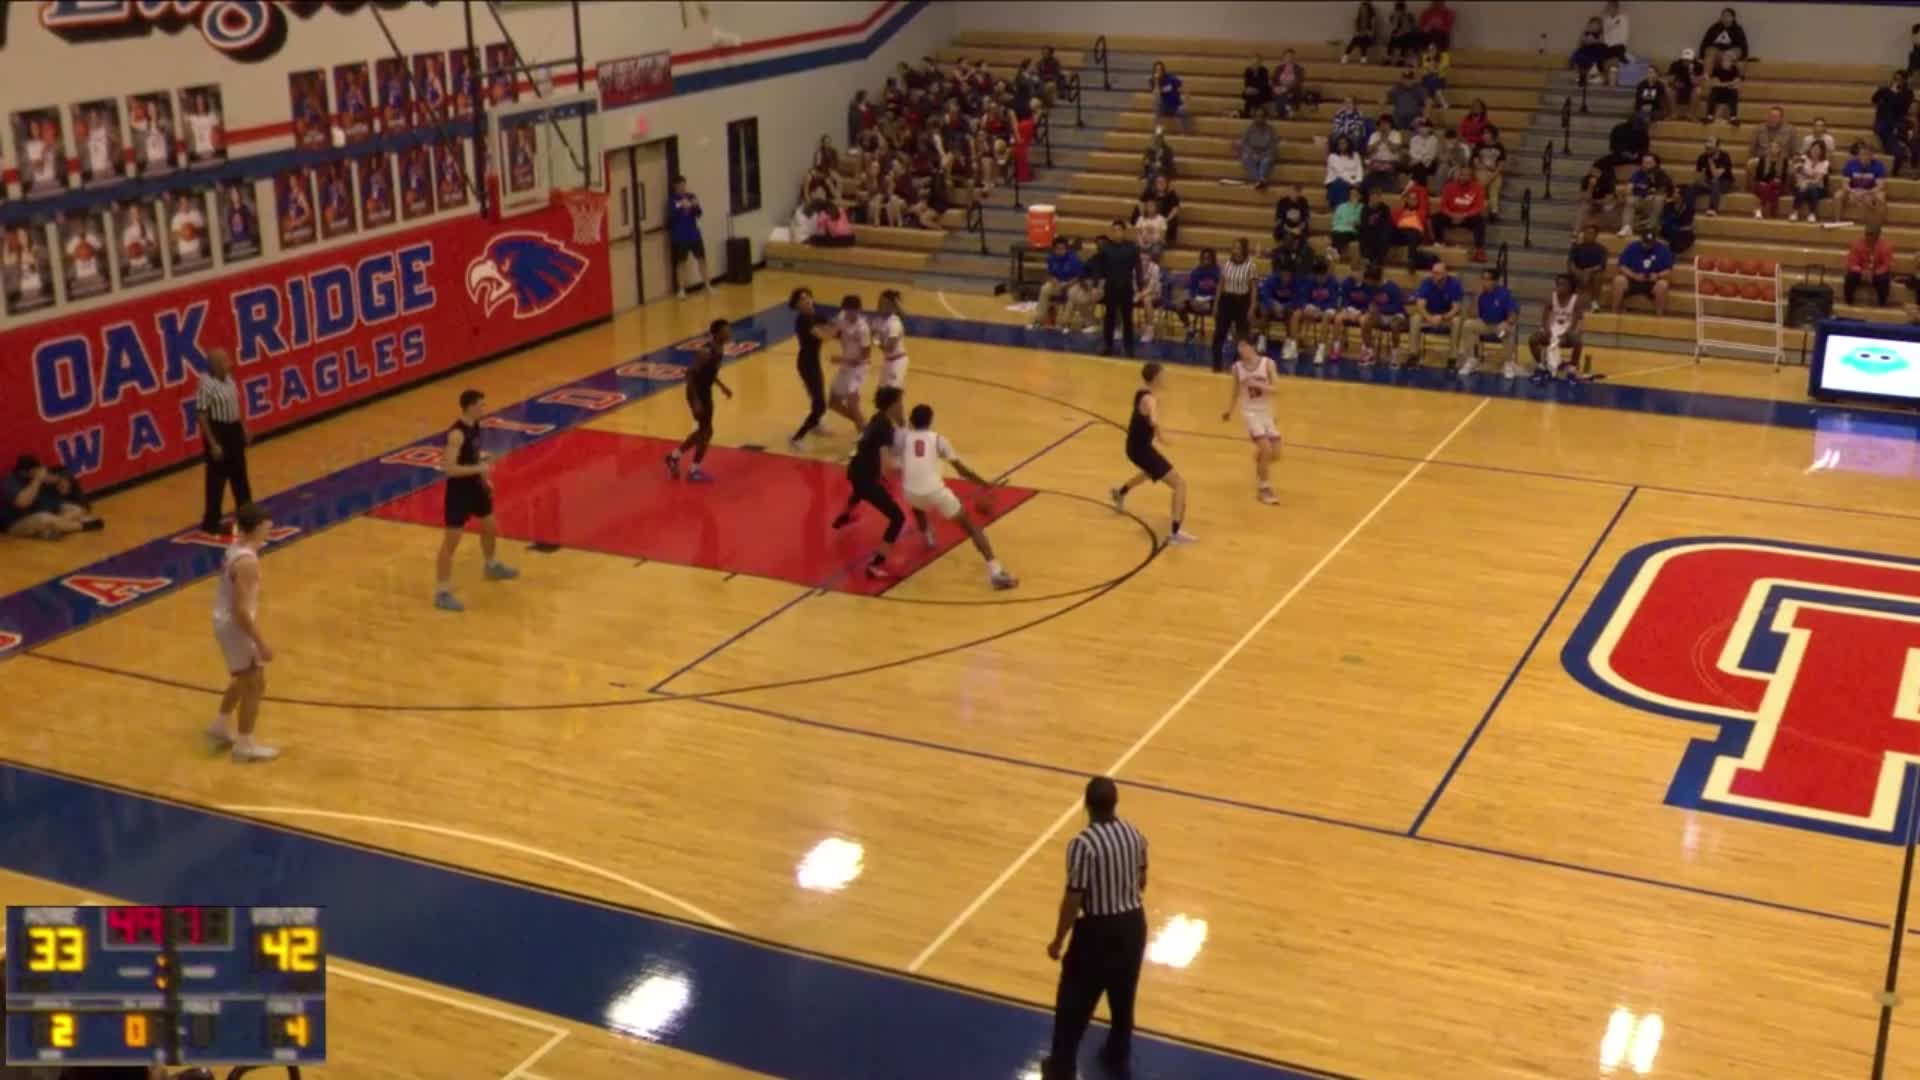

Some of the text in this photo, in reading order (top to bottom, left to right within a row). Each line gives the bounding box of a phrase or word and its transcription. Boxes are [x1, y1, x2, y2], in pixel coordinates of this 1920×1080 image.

[32, 241, 437, 422] OAK RIDGE
[244, 327, 426, 419] EAGLES
